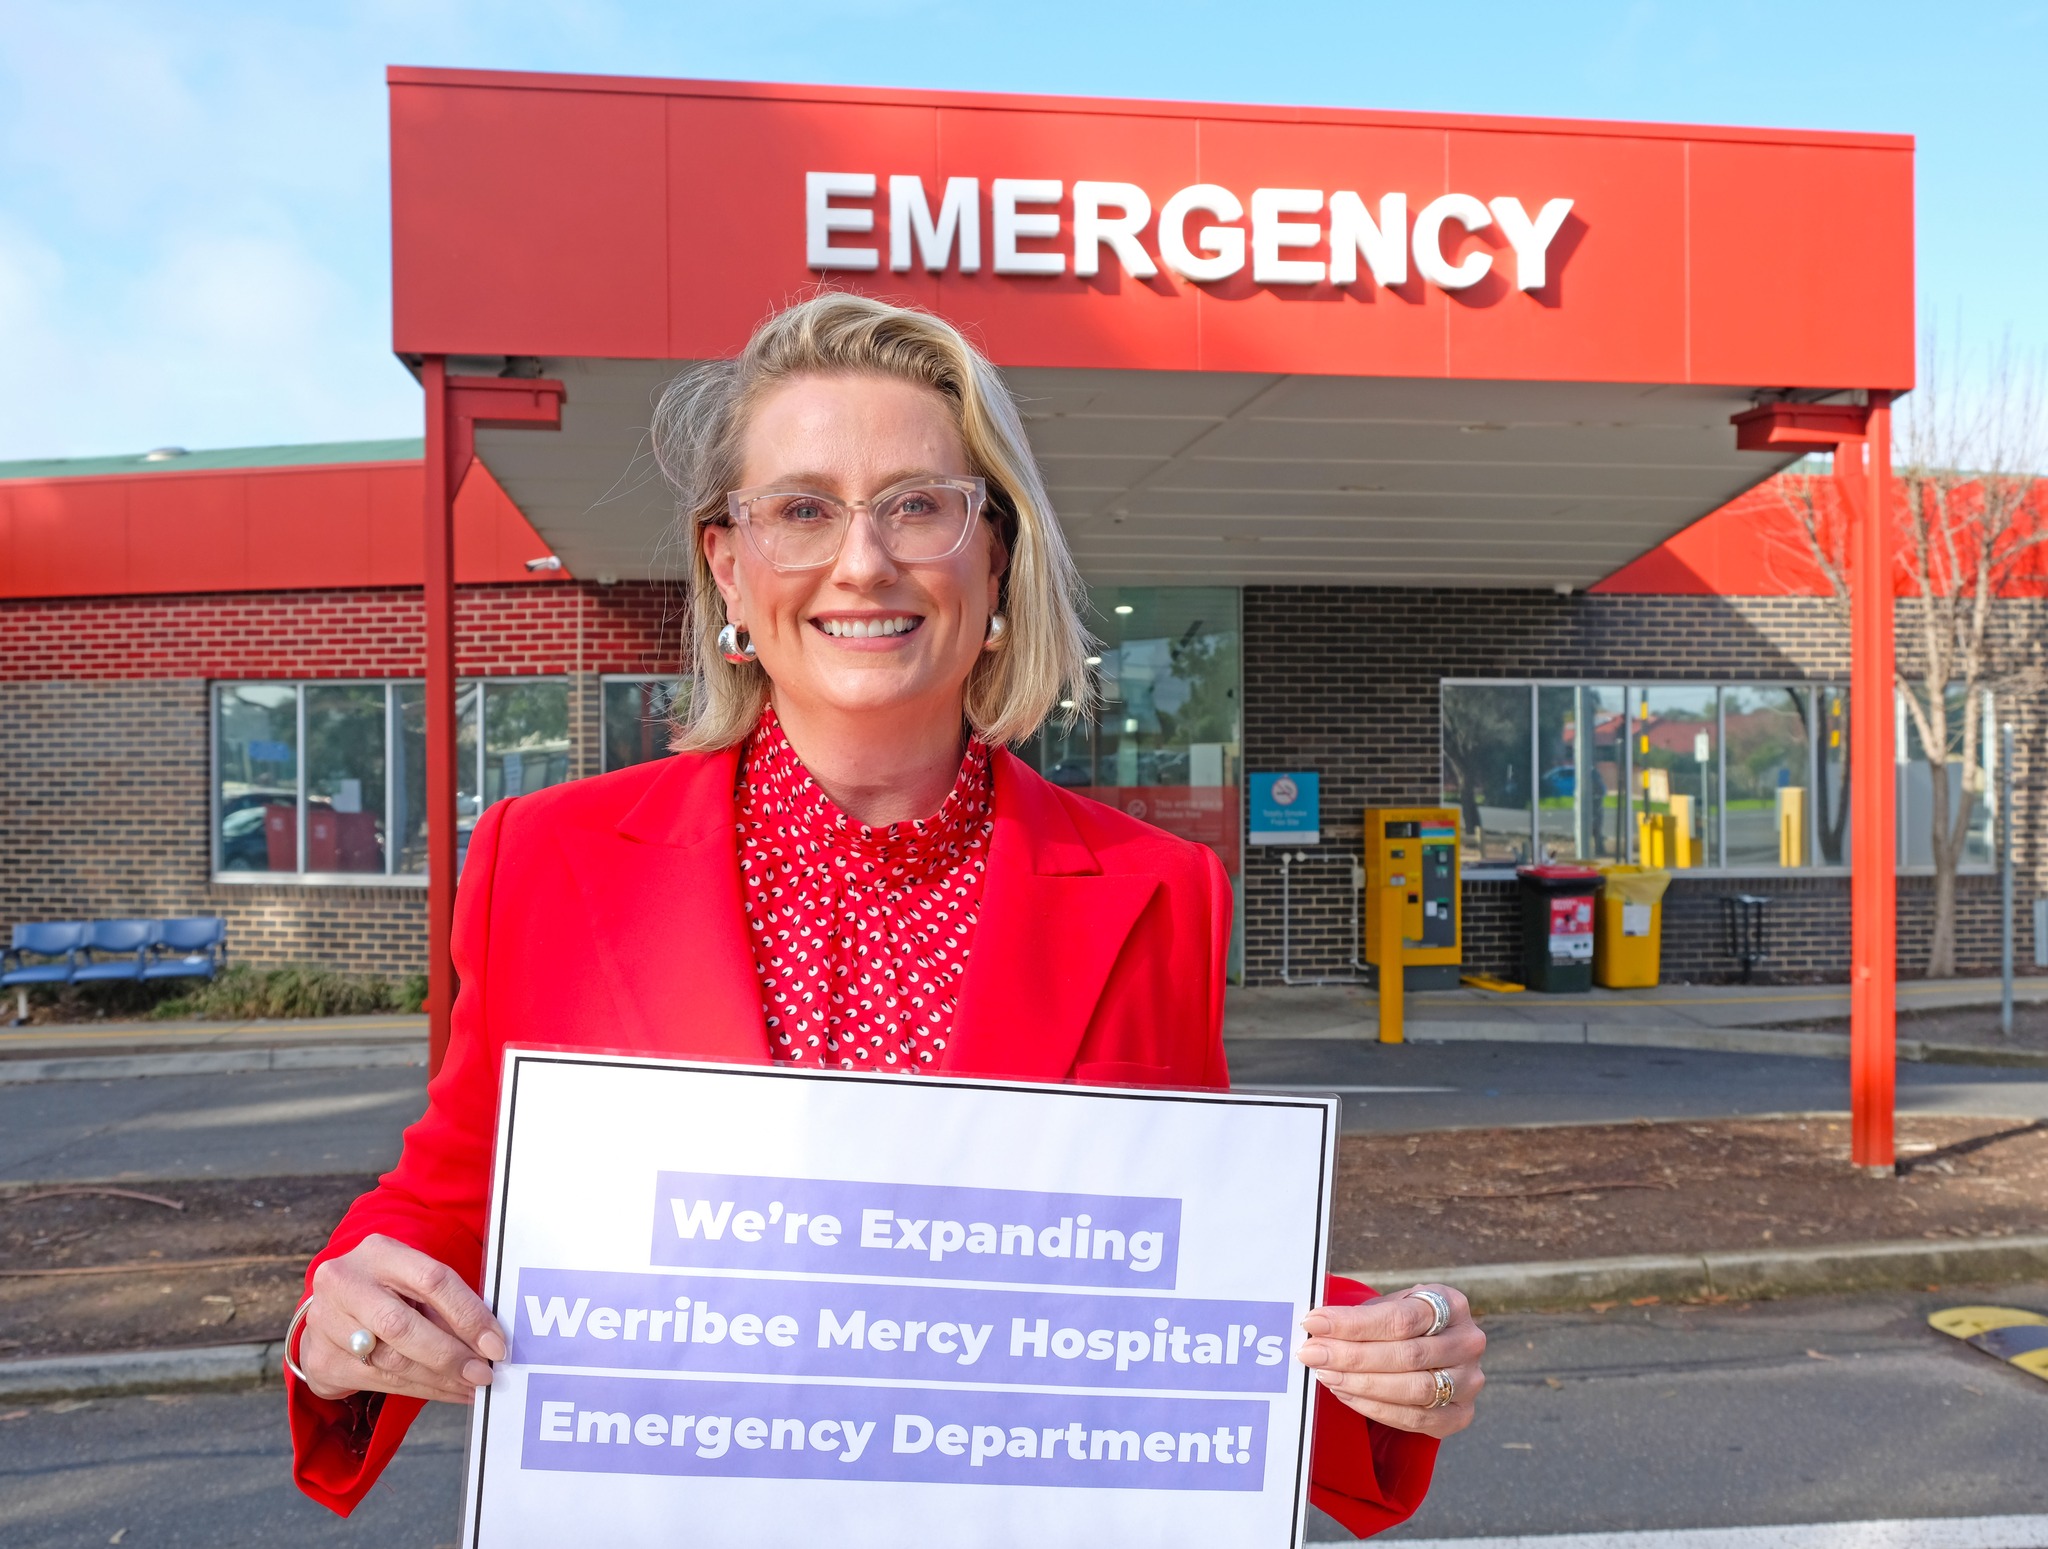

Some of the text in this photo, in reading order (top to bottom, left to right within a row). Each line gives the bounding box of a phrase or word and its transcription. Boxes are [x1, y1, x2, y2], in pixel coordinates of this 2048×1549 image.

[805, 171, 1575, 292] EMERGENCY
[670, 1198, 1164, 1273] We’re Expanding
[524, 1295, 1284, 1371] Werribee Mercy Hospital’s
[539, 1400, 1253, 1467] Emergency Department!
